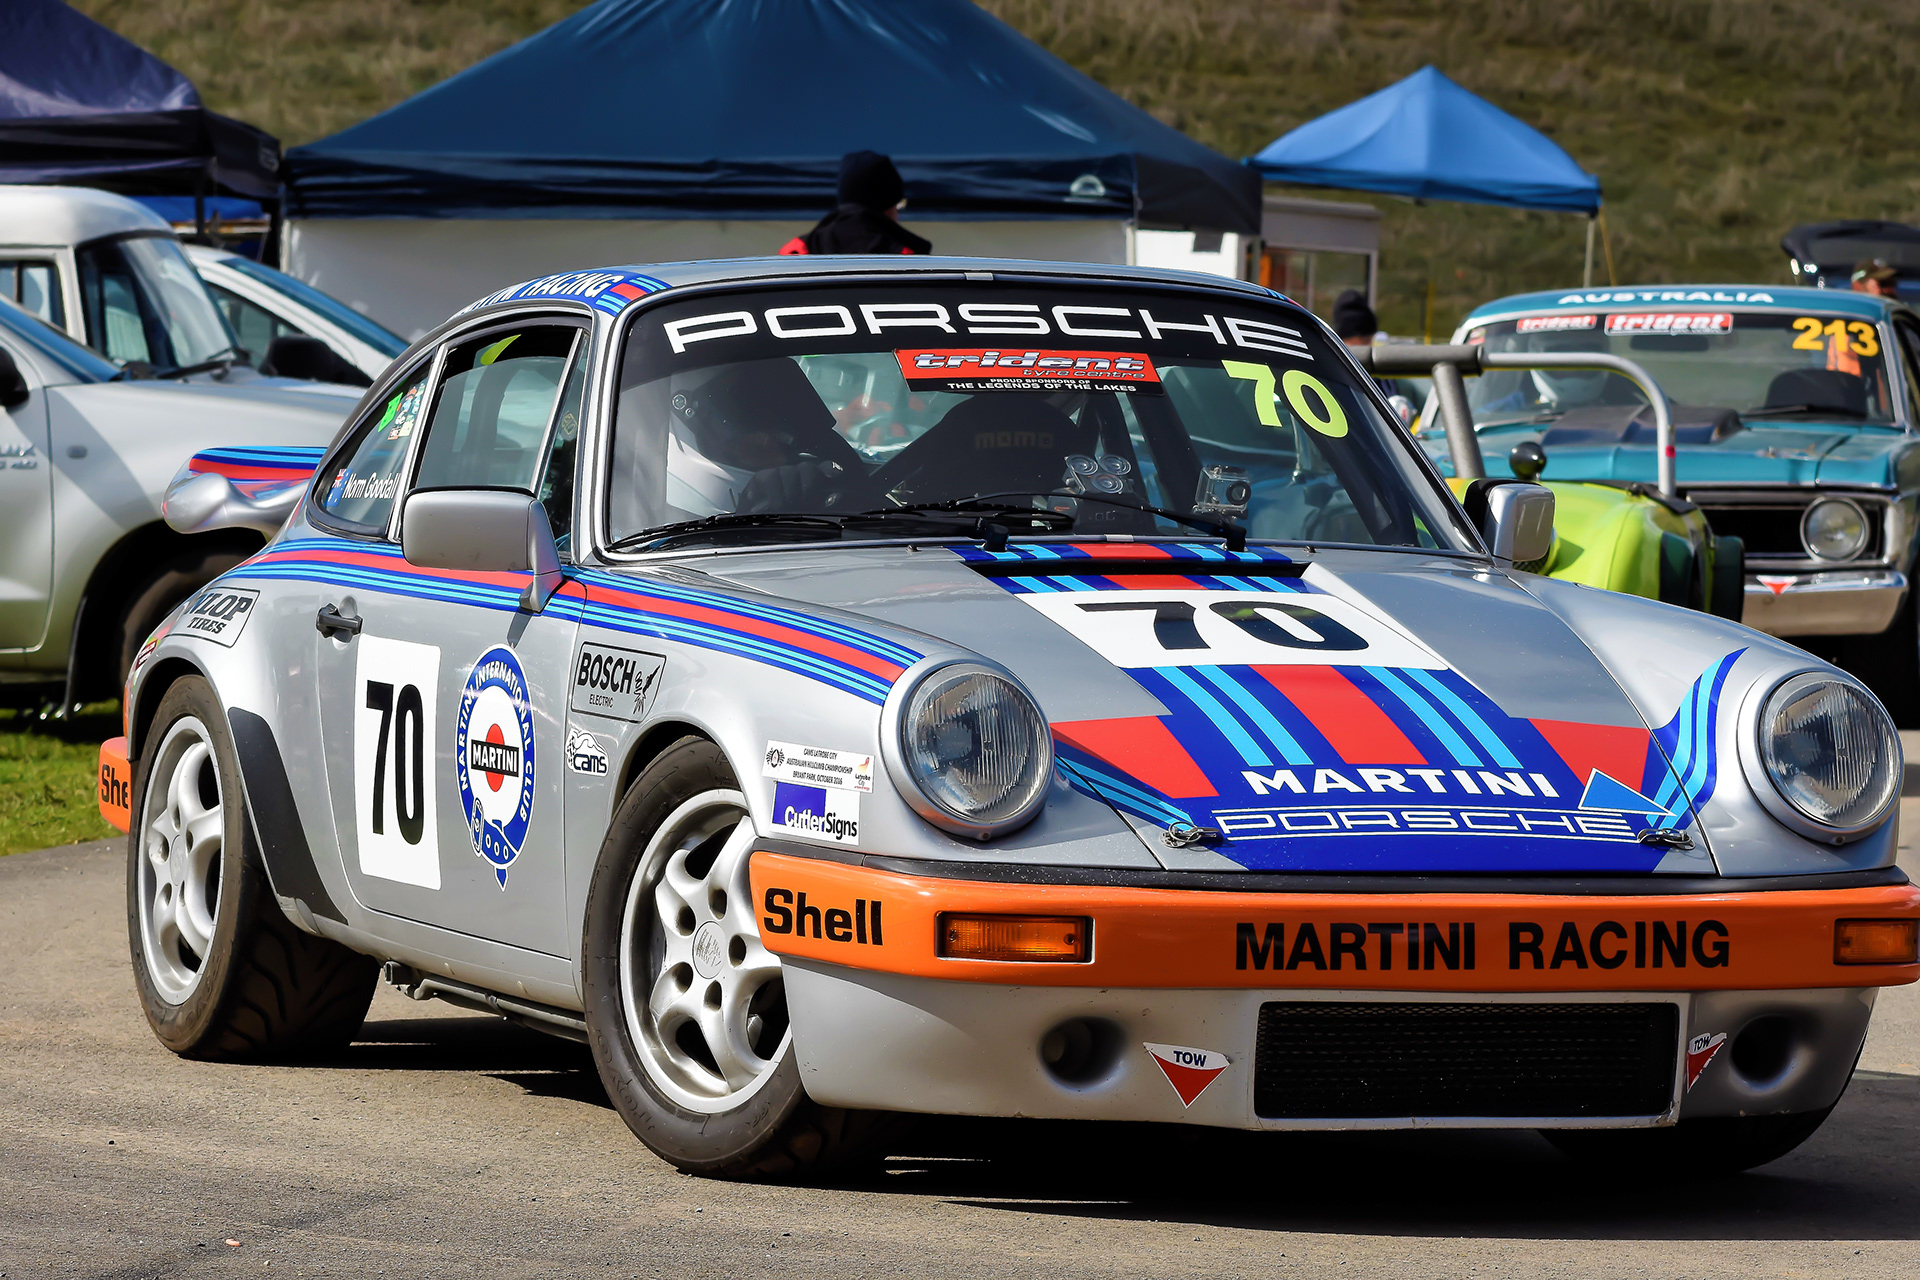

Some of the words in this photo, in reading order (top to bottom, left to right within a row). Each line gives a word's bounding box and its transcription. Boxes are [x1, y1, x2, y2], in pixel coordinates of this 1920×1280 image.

[518, 272, 626, 298] RACING
[1557, 291, 1775, 305] AUSTRALIA
[663, 303, 1314, 361] PORSCHE
[1521, 315, 1592, 330] trident
[1612, 314, 1724, 331] trident
[1792, 317, 1879, 357] 213
[914, 351, 1145, 371] trident
[1022, 369, 1070, 378] tyre
[1075, 369, 1145, 379] centre
[947, 382, 974, 390] THE
[977, 382, 1040, 390] LEGENDS
[1065, 383, 1094, 391] THE
[1095, 384, 1137, 392] LAKES
[1222, 360, 1349, 438] 70
[341, 473, 368, 499] Norm
[364, 472, 401, 499] Goodall
[187, 617, 227, 634] TIRES
[1081, 600, 1370, 651] 70
[577, 652, 637, 694] BOSCH
[475, 660, 532, 751] INTERNATIONAL
[589, 694, 614, 708] ELECTRIC
[458, 684, 475, 791] MARTINI
[366, 680, 425, 845] 70
[472, 742, 518, 773] MARTINI
[573, 753, 607, 774] cams
[101, 764, 129, 809] She
[519, 760, 532, 822] CLUB
[1242, 768, 1560, 798] MARTINI
[1215, 811, 1635, 835] PORSCHE
[763, 887, 884, 946] Shell
[1235, 922, 1476, 970] MARTINI
[1508, 919, 1730, 970] RACING
[1693, 1036, 1710, 1052] TOW
[1173, 1050, 1207, 1068] TOW
